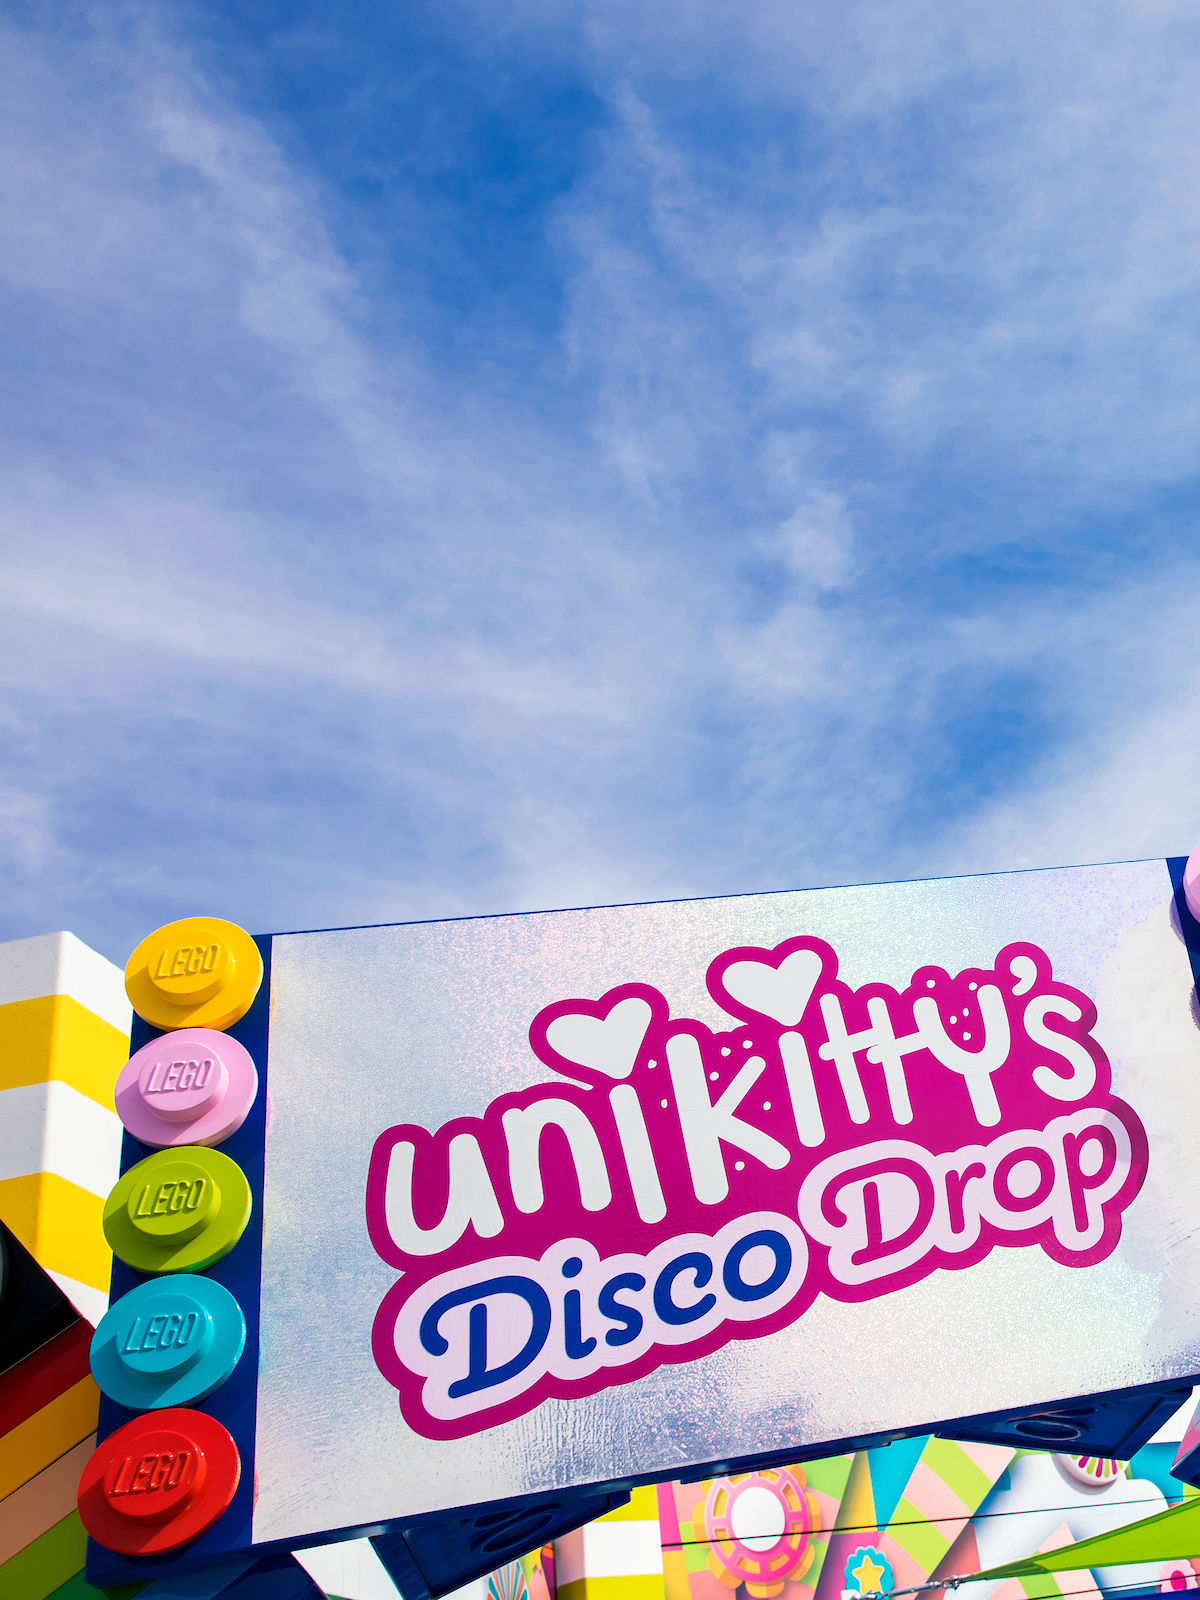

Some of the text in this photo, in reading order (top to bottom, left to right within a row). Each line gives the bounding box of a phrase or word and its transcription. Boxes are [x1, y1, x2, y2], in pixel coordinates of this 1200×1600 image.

[156, 944, 219, 978] LEGO
[147, 1058, 215, 1093] LEGO
[136, 1178, 207, 1217] LEGO
[419, 1122, 1106, 1400] Disco Drop
[125, 1312, 196, 1352] LEGO
[111, 1452, 190, 1496] LEGO
